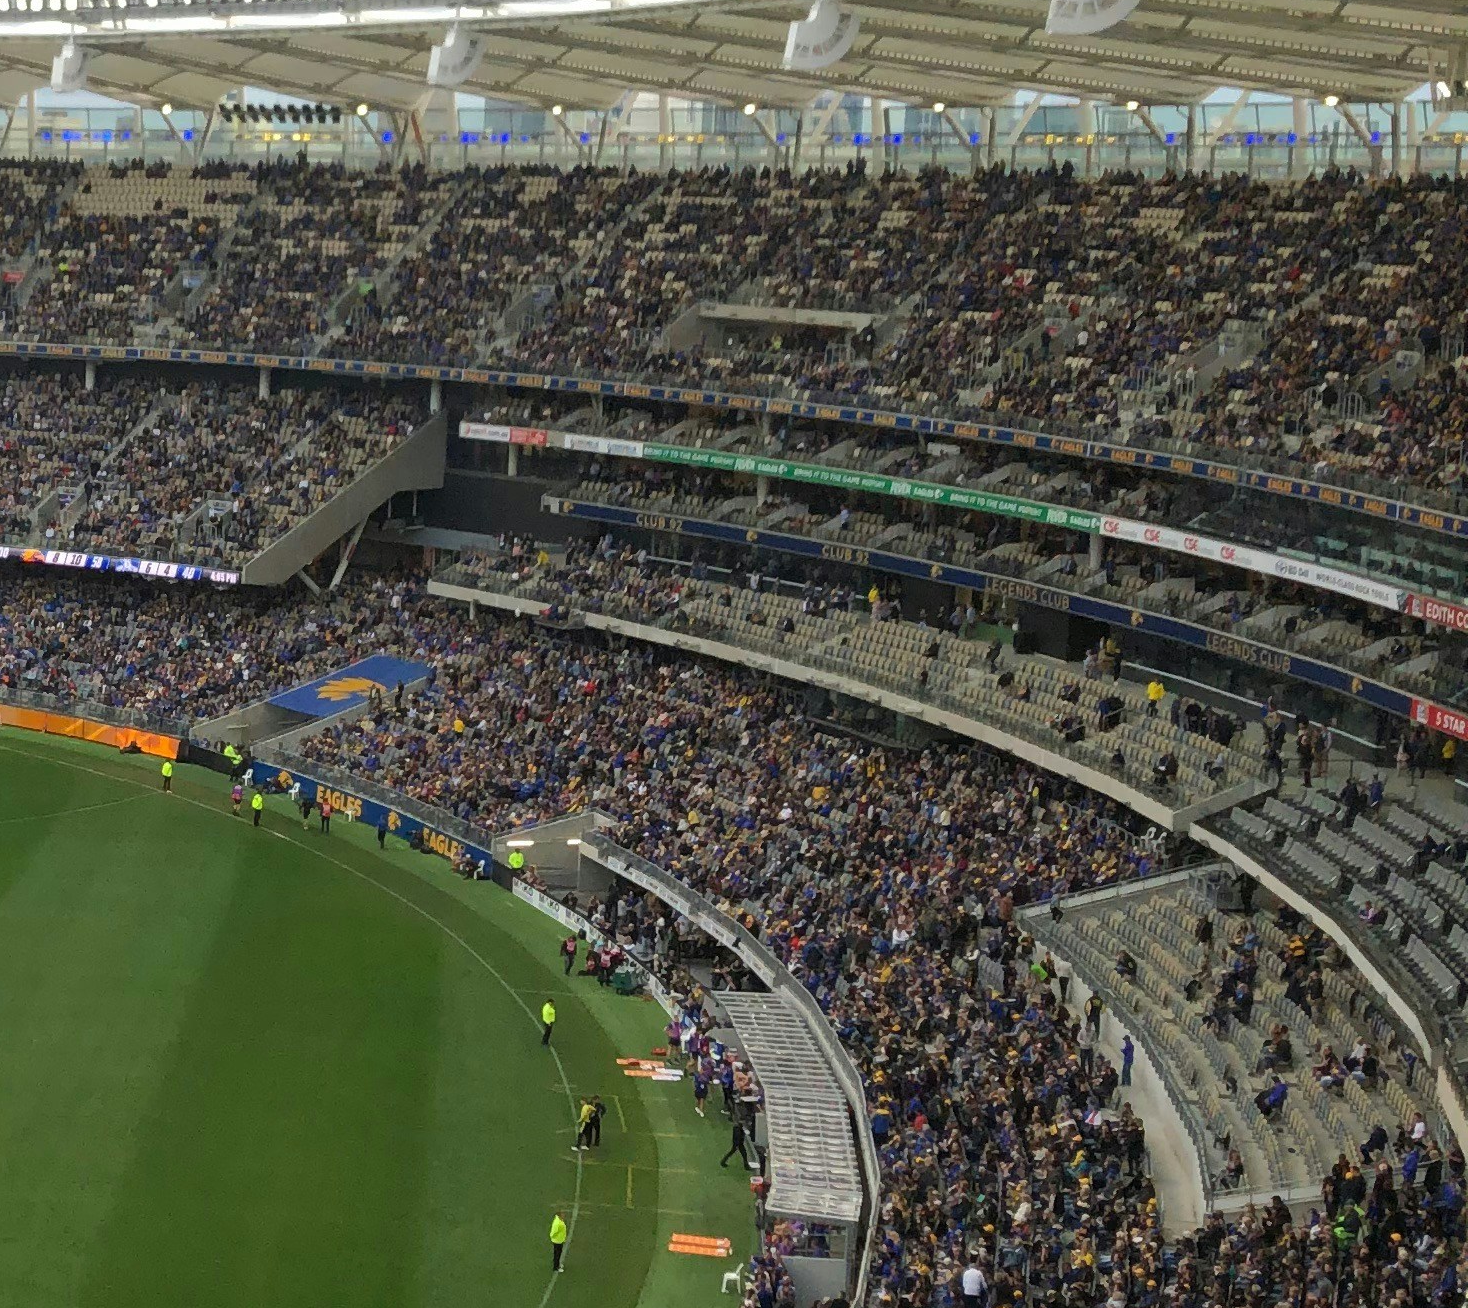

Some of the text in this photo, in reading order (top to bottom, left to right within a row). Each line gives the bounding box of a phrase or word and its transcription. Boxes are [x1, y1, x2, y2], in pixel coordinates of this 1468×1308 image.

[636, 514, 665, 528] CLUB
[821, 545, 851, 561] CLUB
[163, 565, 171, 575] 4
[985, 578, 1071, 610] LEGENDS CLUB
[1426, 603, 1454, 624] EDITH
[1207, 634, 1292, 671] LEGENDS CLUB
[1436, 712, 1465, 734] 5 STAR
[317, 785, 362, 817] EAGLES
